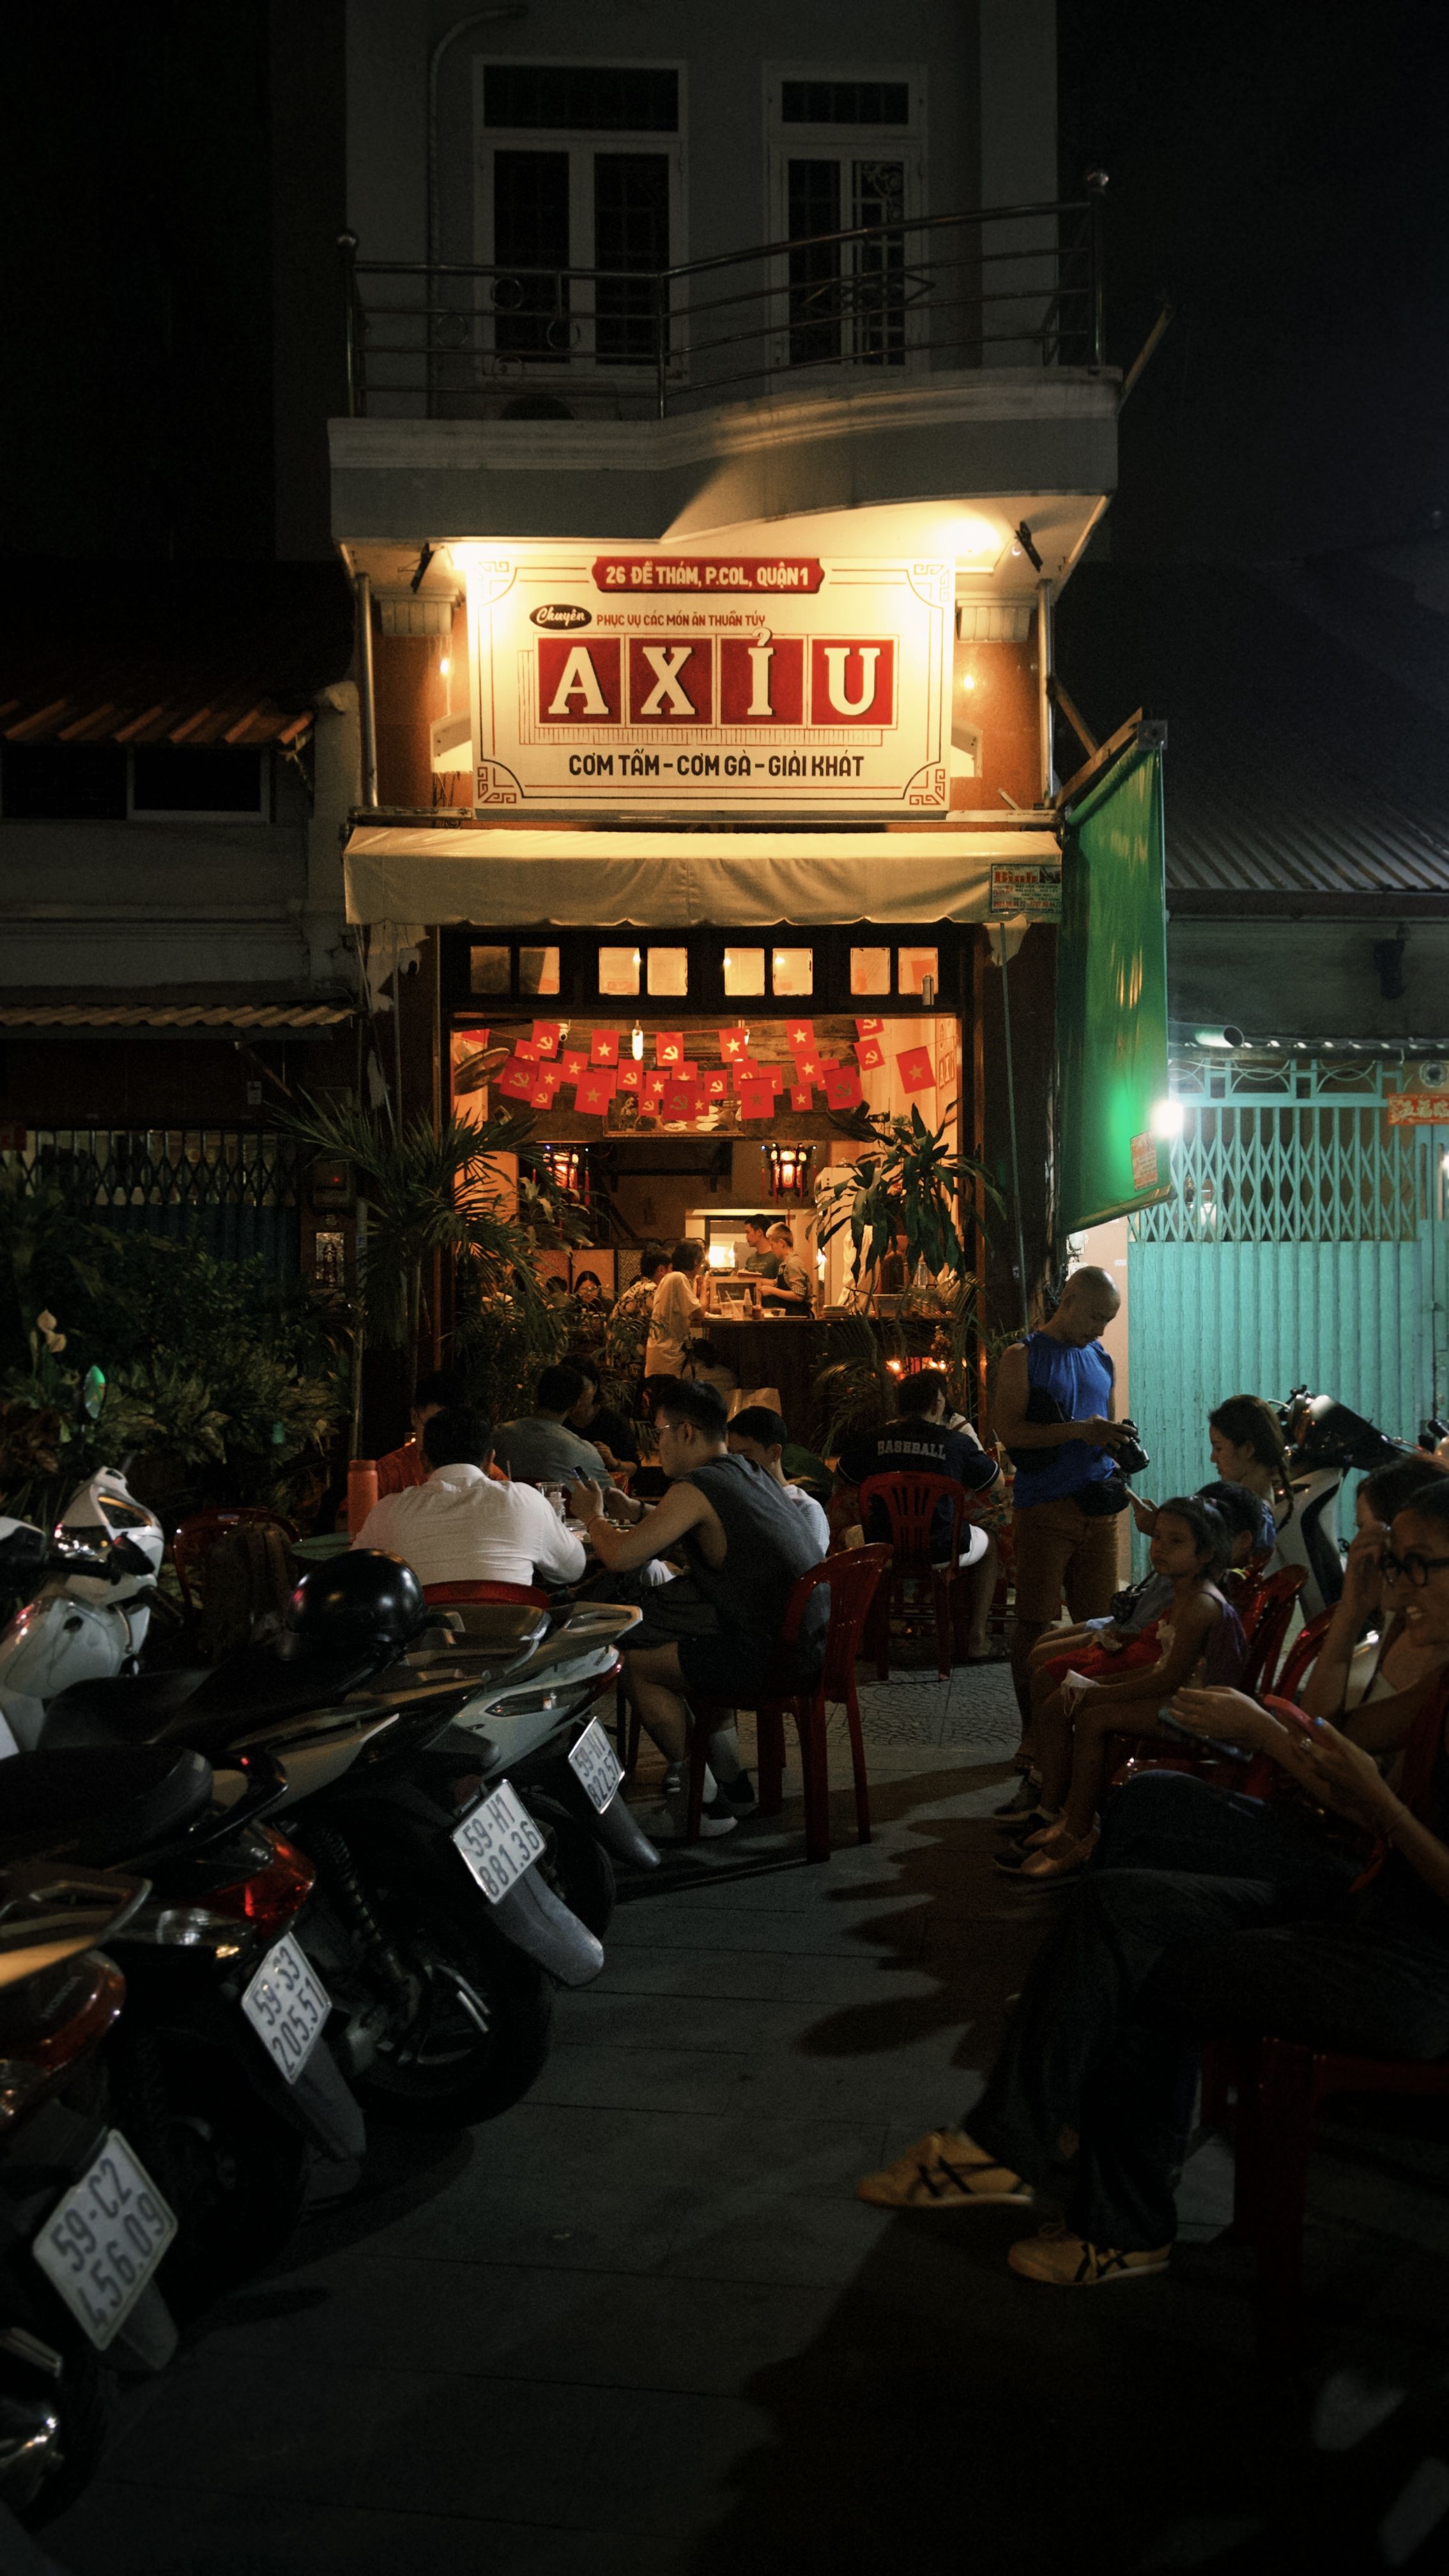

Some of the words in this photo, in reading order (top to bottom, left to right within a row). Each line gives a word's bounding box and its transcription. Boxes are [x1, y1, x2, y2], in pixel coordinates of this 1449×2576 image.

[606, 565, 626, 585] 26
[631, 561, 654, 585] ĐỀ
[656, 561, 702, 588] THÁM,
[705, 566, 752, 588] P.COL,
[535, 604, 586, 627] Chuyên
[597, 614, 625, 629] PHỤC
[627, 614, 640, 629] VỤ
[644, 610, 665, 627] CÁC
[666, 610, 689, 627] MÓN
[692, 610, 706, 626] ĂN
[709, 610, 743, 627] THUẦN
[745, 610, 766, 627] TÚY
[569, 751, 613, 776] CƠM
[618, 748, 660, 776] TẤM
[677, 751, 719, 776] CƠM
[724, 749, 751, 776] GÀ
[768, 750, 807, 776] GIẢI
[811, 749, 864, 776] KHÁT
[877, 1439, 946, 1460] BASEBALL
[462, 1792, 516, 1857] 59-H1
[479, 1820, 540, 1897] 881.36
[272, 1976, 325, 2073] 205.51
[50, 2158, 132, 2272] 59-C2
[77, 2191, 166, 2329] 456.09
